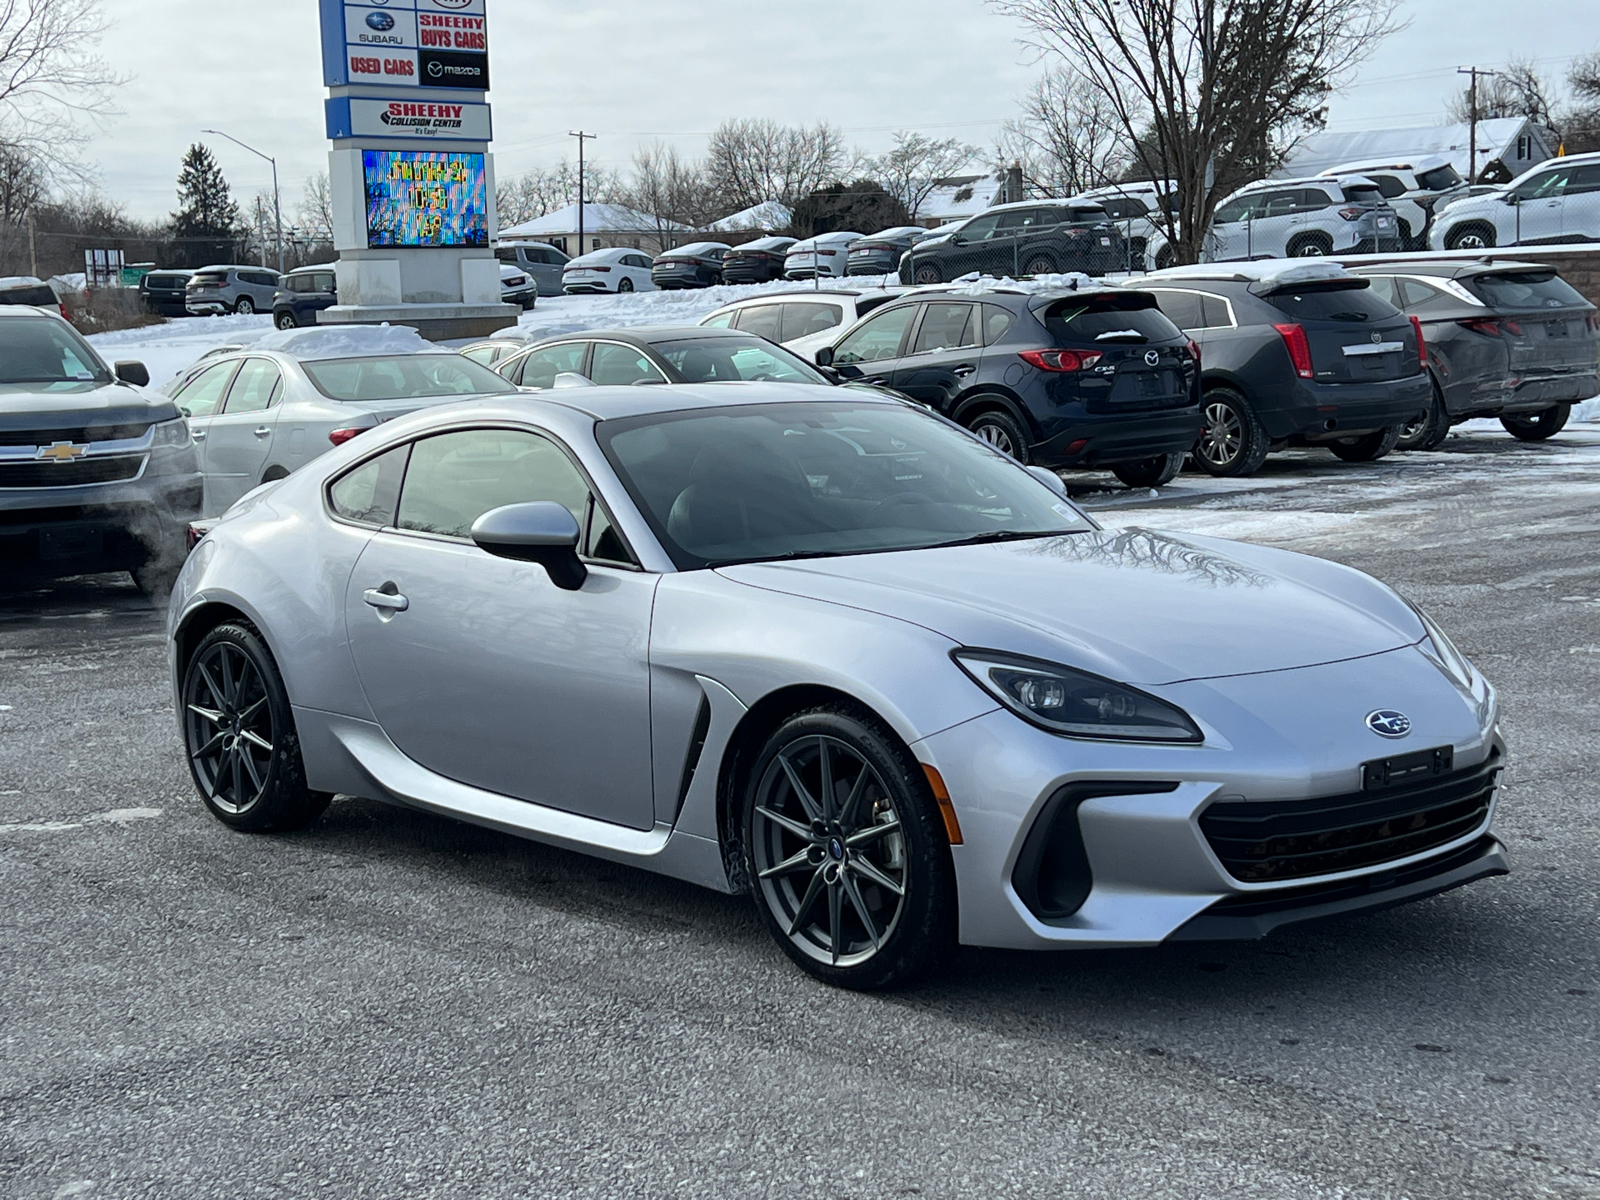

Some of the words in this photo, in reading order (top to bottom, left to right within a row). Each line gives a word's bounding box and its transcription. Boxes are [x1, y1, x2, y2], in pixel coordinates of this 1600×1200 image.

[419, 14, 484, 30] SHEEHY
[359, 34, 403, 45] SUBARU
[421, 29, 451, 48] BUYS
[454, 31, 485, 50] CARS
[350, 57, 380, 74] USED
[384, 59, 414, 76] CARS
[444, 65, 481, 76] mazda
[388, 103, 463, 118] SHEEHY
[390, 117, 431, 127] COLLISION
[433, 119, 462, 128] CENTER
[415, 127, 423, 135] It's
[424, 128, 438, 136] Easy!
